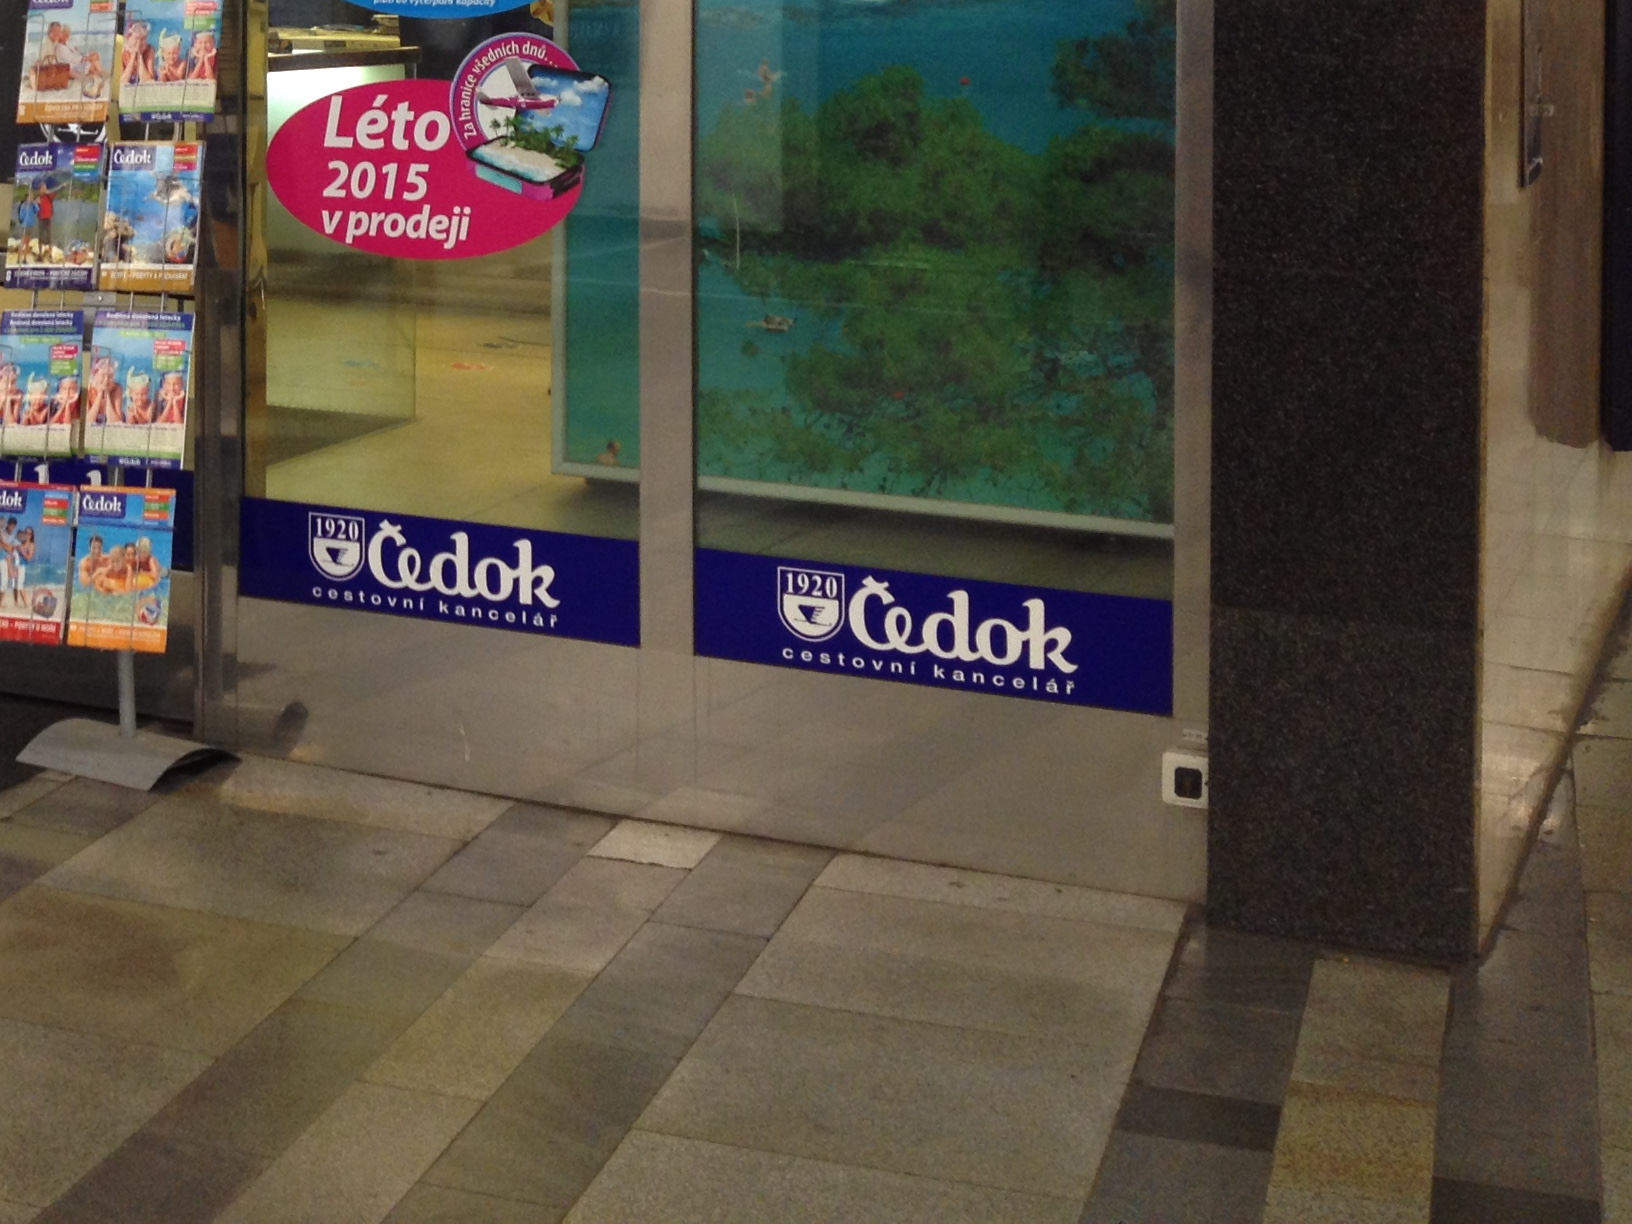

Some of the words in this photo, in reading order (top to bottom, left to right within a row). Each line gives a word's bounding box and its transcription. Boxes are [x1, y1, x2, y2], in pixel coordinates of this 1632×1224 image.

[459, 74, 477, 121] hranice
[472, 40, 520, 75] všedních
[323, 94, 451, 151] Léto
[19, 151, 53, 167] Čedok
[114, 149, 152, 165] Čedok
[322, 160, 429, 201] 2015
[322, 210, 343, 235] v
[345, 205, 472, 250] prodeji
[82, 495, 122, 512] Čedok
[314, 515, 360, 542] 1920
[368, 519, 561, 610] Čedok
[311, 585, 426, 612] cestovní
[438, 600, 560, 629] kancelář
[784, 571, 840, 599] 1920
[848, 575, 1078, 674] Čedok
[782, 647, 917, 678] cestovní
[933, 663, 1076, 696] kancelář
